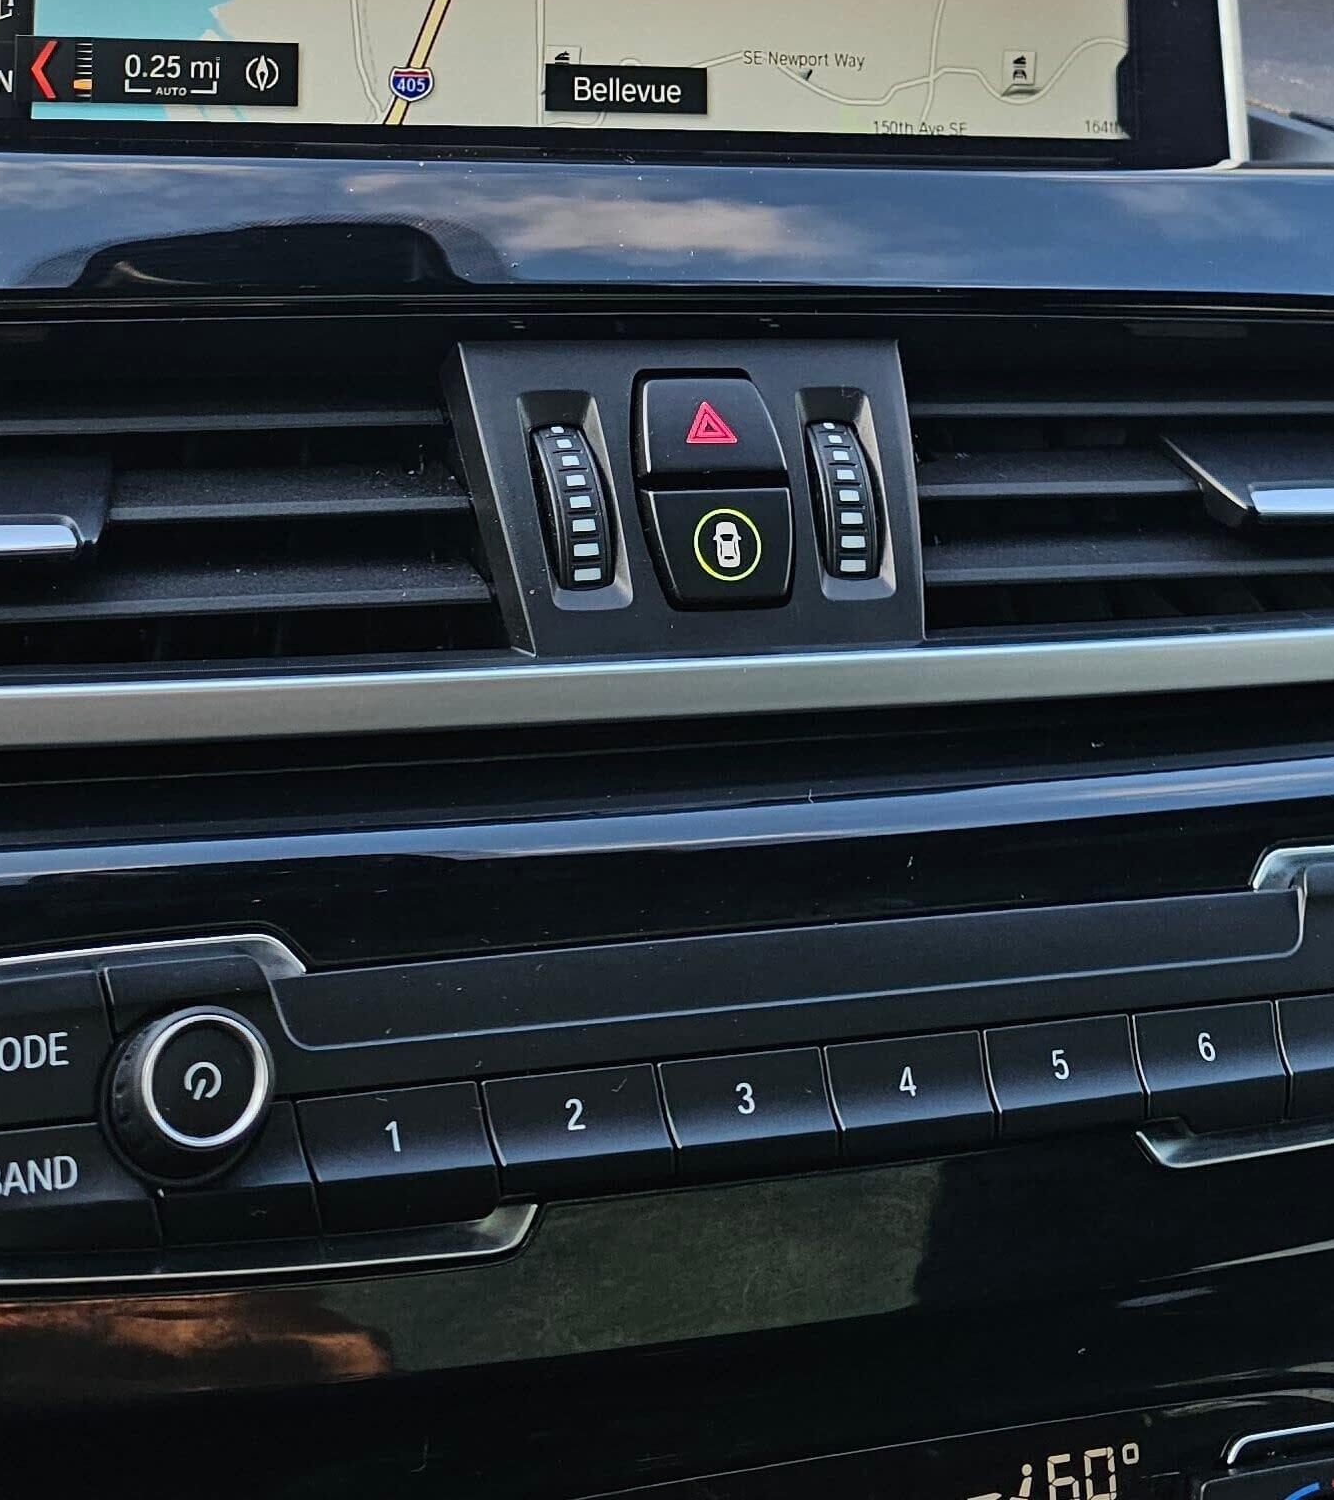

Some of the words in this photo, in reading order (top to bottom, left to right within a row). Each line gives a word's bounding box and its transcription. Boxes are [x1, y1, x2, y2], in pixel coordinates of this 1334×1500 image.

[125, 54, 181, 79] 0.25
[190, 56, 221, 79] mi
[743, 50, 763, 66] SE
[768, 51, 831, 70] Newport
[834, 52, 865, 71] Way
[155, 86, 188, 97] AUTO
[396, 76, 427, 93] 405
[573, 76, 682, 105] Bellevue
[873, 120, 914, 134] 150th
[918, 122, 944, 136] Ave
[1197, 1032, 1216, 1063] 6
[1051, 1048, 1069, 1081] 5
[898, 1065, 917, 1099] 4
[737, 1082, 755, 1116] 3
[565, 1099, 584, 1132] 2
[384, 1120, 402, 1153] 1
